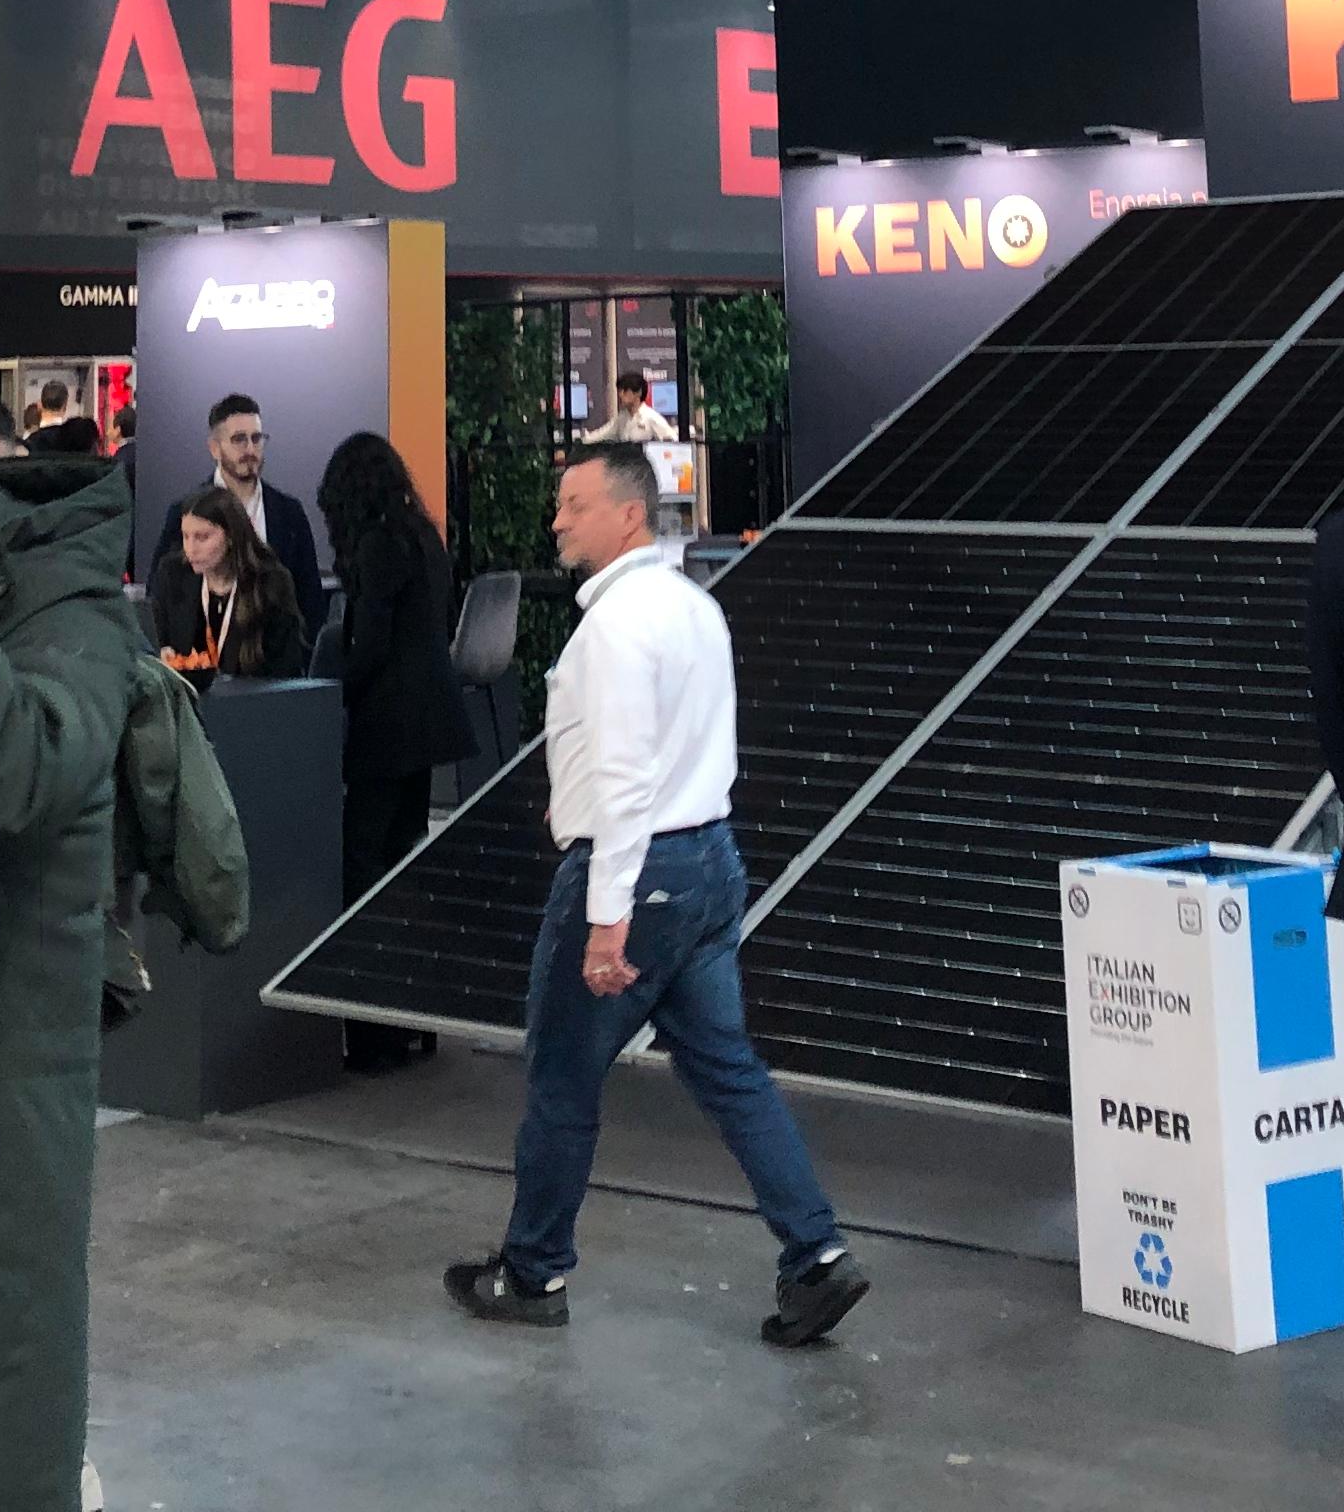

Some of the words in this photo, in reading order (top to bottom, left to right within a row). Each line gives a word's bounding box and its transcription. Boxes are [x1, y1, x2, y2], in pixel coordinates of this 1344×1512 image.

[814, 194, 1049, 278] KENO
[60, 285, 124, 307] GAMMA
[1087, 953, 1155, 984] ITALIAN
[1088, 978, 1191, 1016] EXHIBITION
[1089, 1003, 1153, 1032] GROUP
[1100, 1098, 1192, 1144] PAPER
[1122, 1190, 1158, 1211] DON'T
[1161, 1199, 1178, 1215] BE
[1127, 1207, 1174, 1231] TRASHY
[1122, 1286, 1190, 1324] RECYCLE
